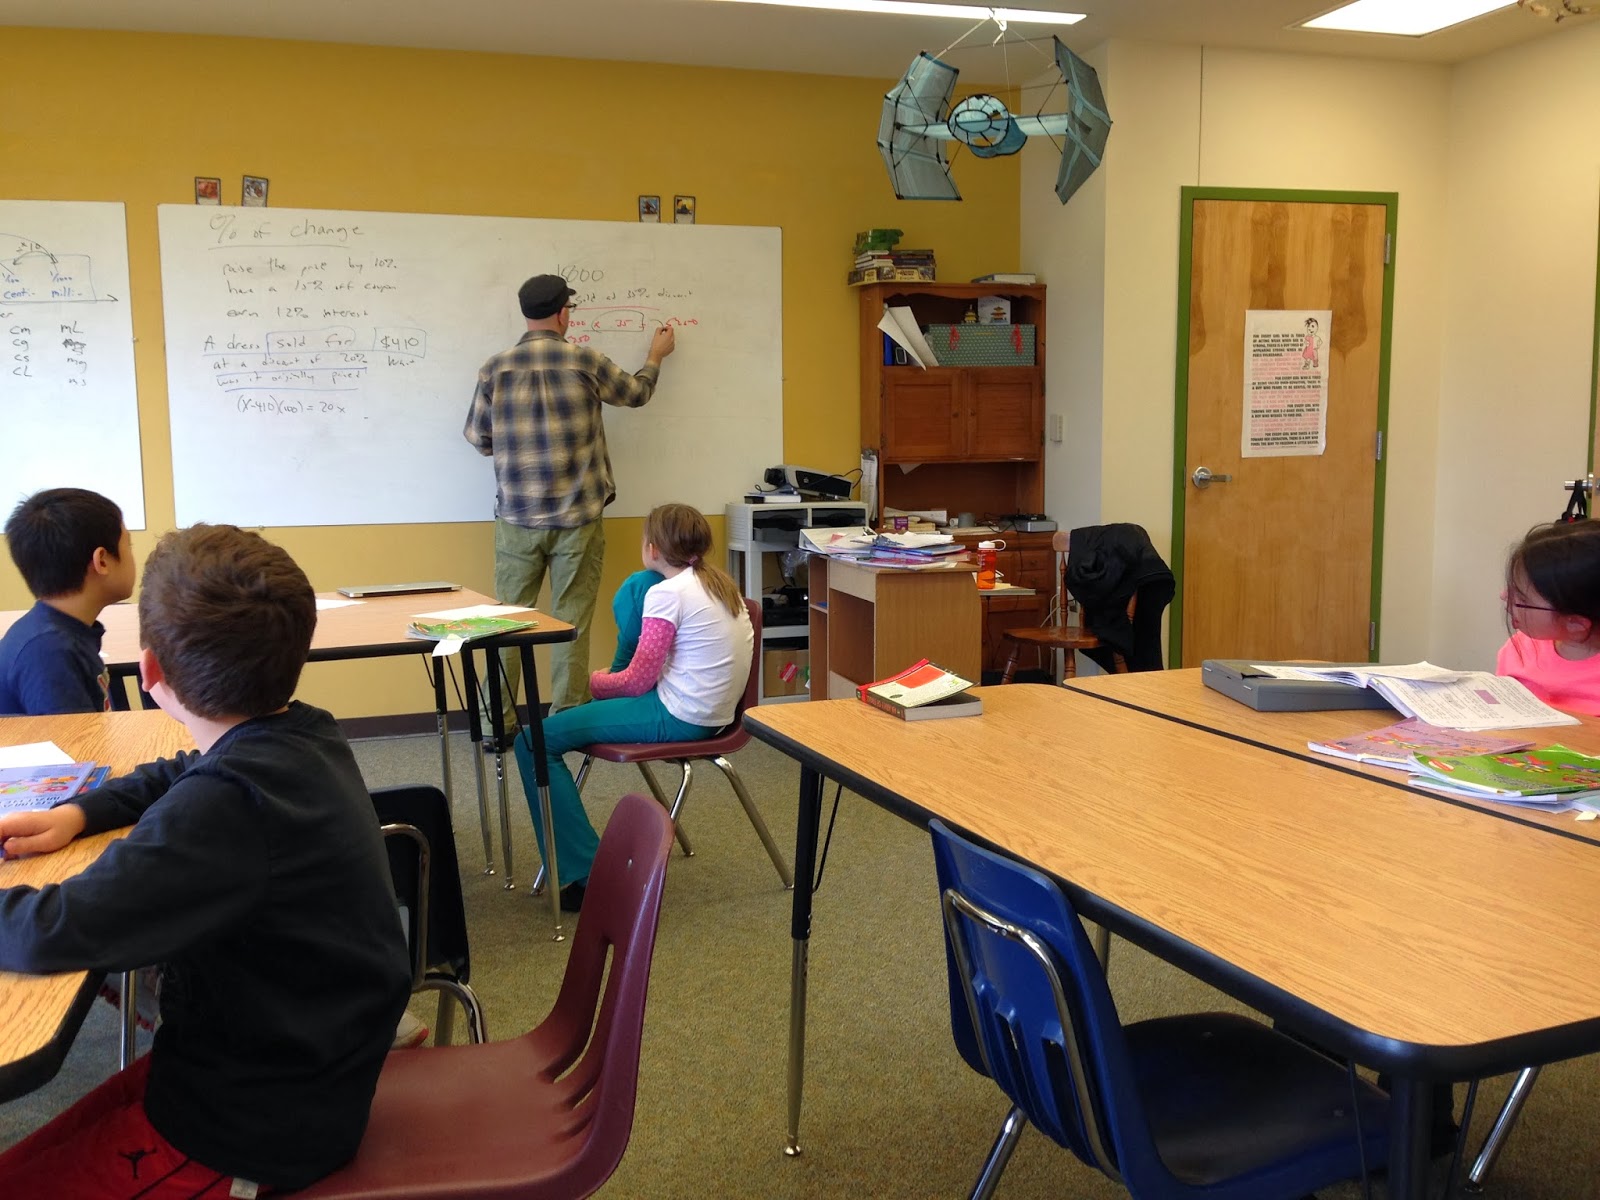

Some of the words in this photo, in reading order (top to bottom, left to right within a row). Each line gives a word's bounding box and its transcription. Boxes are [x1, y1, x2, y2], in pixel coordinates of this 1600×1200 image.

[253, 222, 271, 239] of
[290, 219, 365, 242] change
[268, 258, 286, 272] the
[349, 258, 363, 273] by
[226, 309, 258, 318] earn
[204, 337, 215, 353] A
[325, 334, 352, 347] for
[380, 336, 420, 351] $410
[213, 357, 229, 370] at
